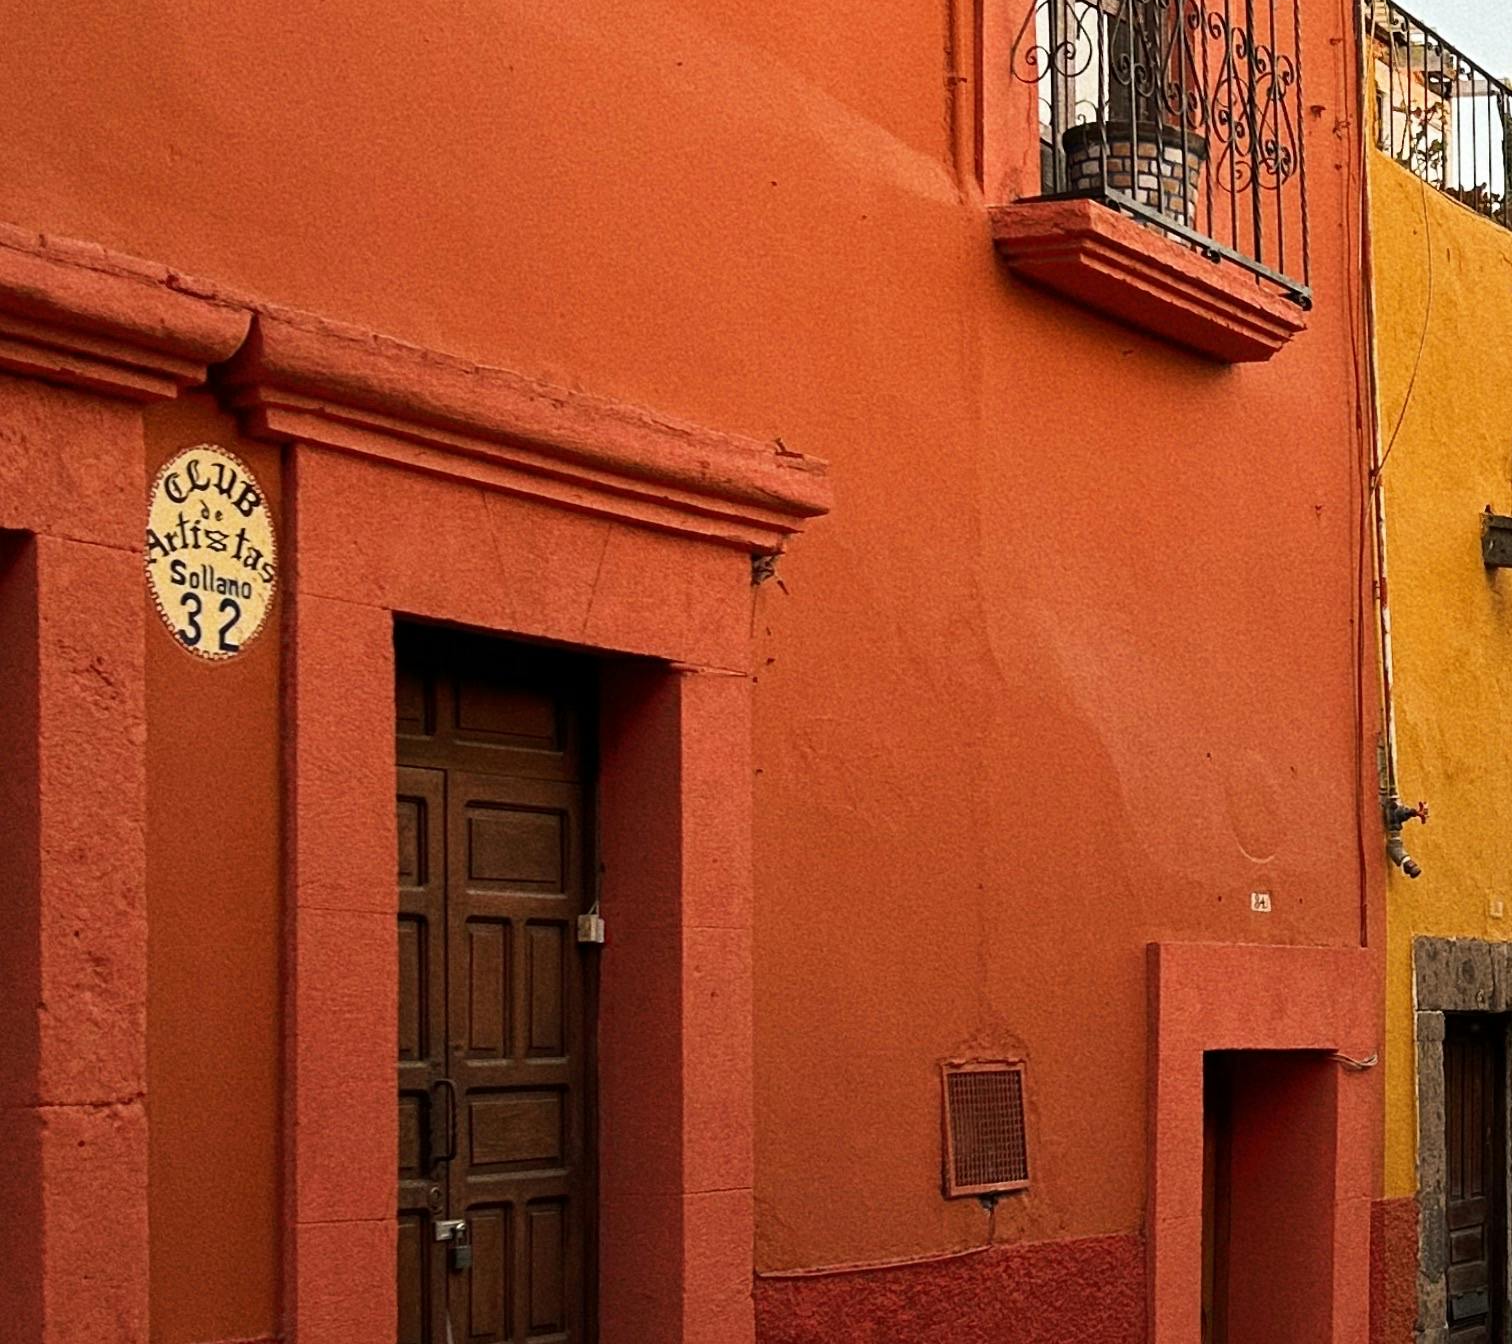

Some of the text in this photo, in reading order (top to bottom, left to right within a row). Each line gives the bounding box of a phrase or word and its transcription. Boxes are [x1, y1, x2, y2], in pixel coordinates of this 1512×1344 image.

[164, 459, 262, 517] CLUB
[200, 499, 222, 521] de
[145, 511, 274, 584] Artistas
[170, 559, 252, 599] Sollano
[178, 592, 241, 652] 32
